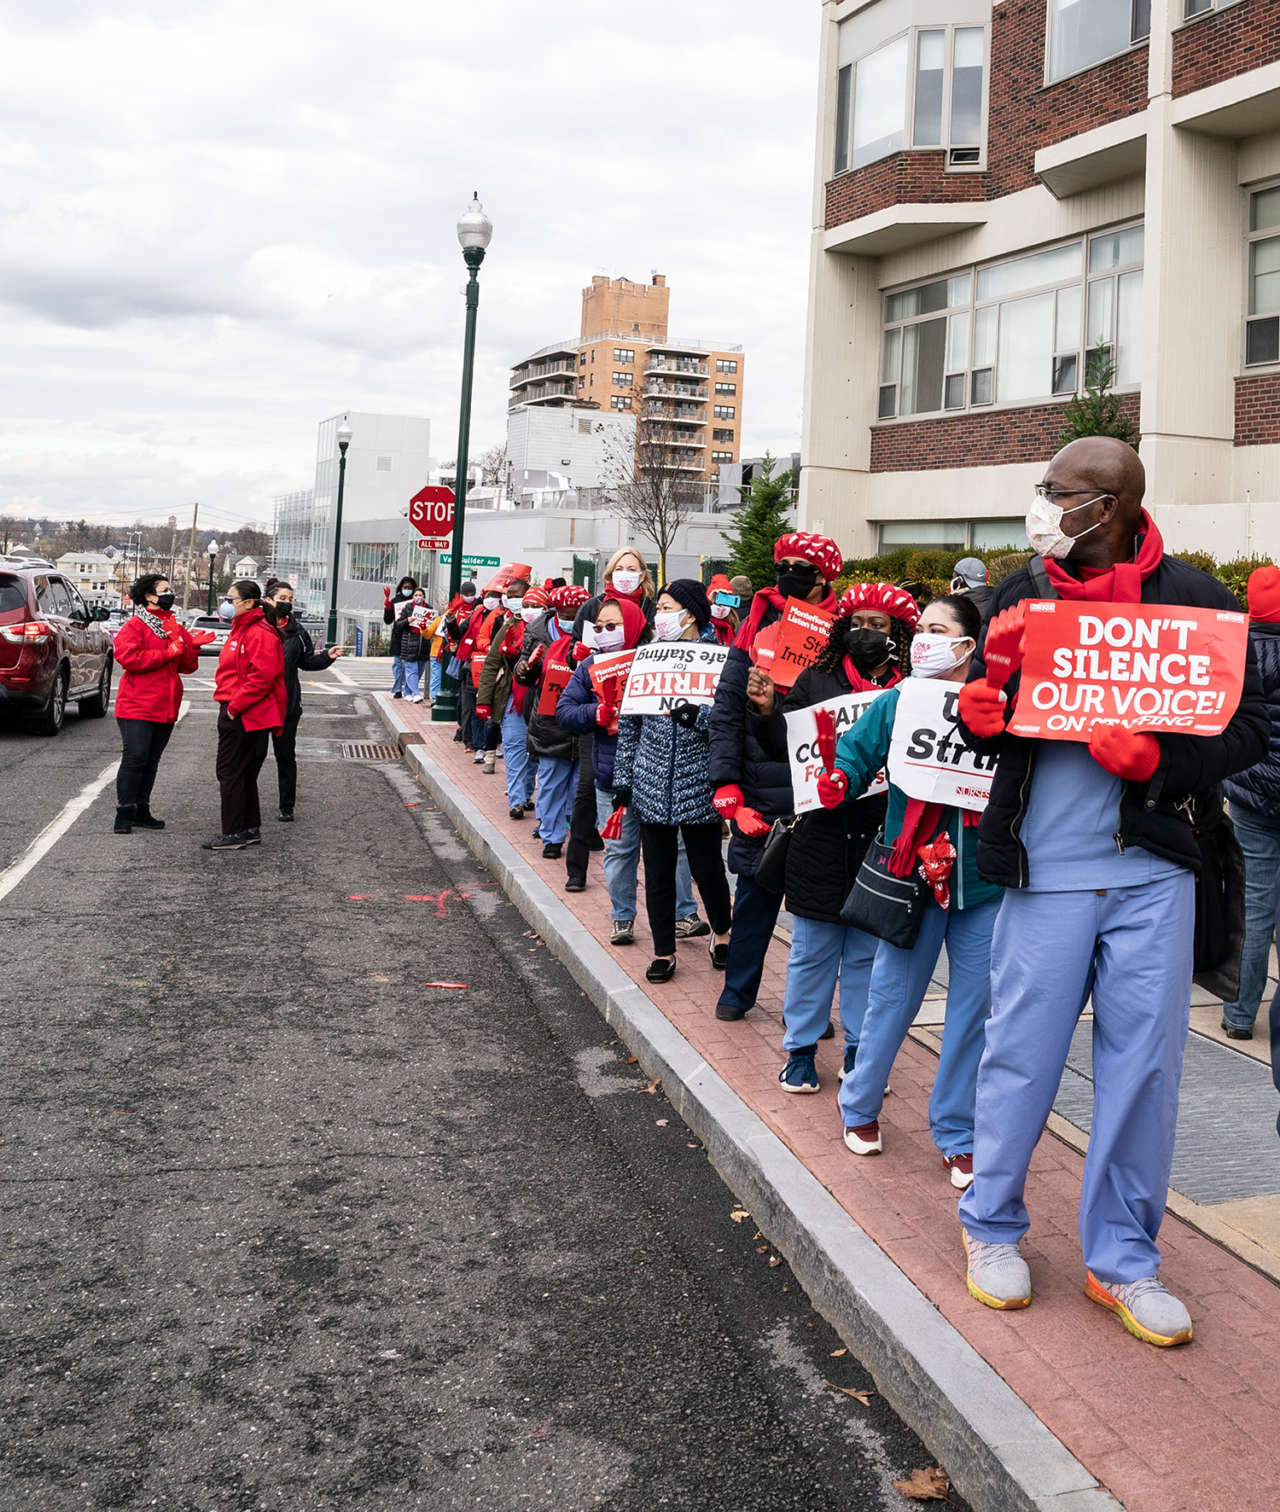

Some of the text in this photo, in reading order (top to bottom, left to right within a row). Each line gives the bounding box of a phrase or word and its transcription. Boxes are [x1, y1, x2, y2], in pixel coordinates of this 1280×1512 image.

[412, 501, 455, 521] STOP
[462, 555, 484, 565] uilder
[1078, 615, 1198, 650] DON'T
[635, 649, 727, 665] afe Staffing
[672, 663, 687, 671] for
[1052, 648, 1211, 686] SILENCE
[630, 672, 720, 696] STRIKE
[1031, 681, 1226, 716] OUR VOICE!
[1046, 714, 1086, 732] ON
